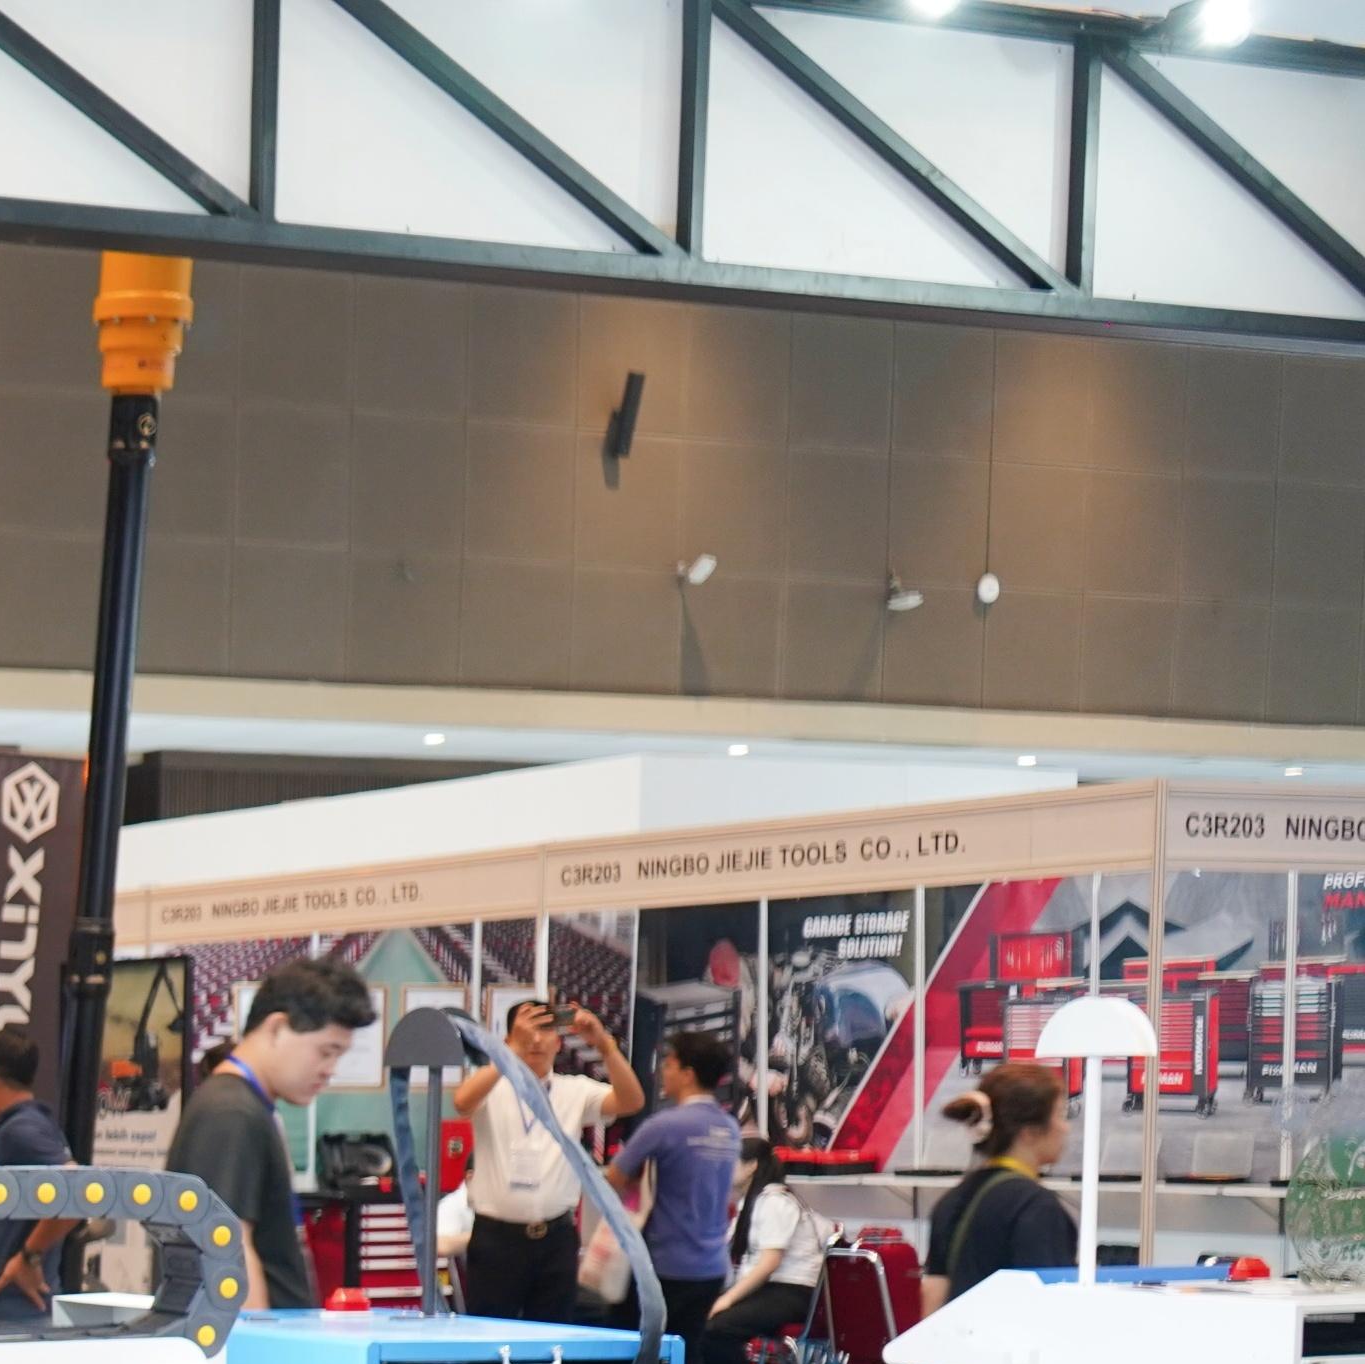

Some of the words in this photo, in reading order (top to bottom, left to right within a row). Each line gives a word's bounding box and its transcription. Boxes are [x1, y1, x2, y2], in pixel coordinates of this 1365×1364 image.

[1185, 811, 1266, 839] C3R203
[560, 864, 622, 888] C3R203
[637, 853, 710, 880] NINGBO
[715, 847, 772, 874] JIEJIE
[779, 840, 847, 868] TOOLS
[1323, 870, 1365, 891] PROF
[212, 899, 260, 921] NINGBO
[262, 894, 300, 916] JIEJIE
[304, 889, 348, 912] TOOLS
[803, 912, 853, 939] GARAGE
[854, 909, 911, 936] STORAGE
[837, 933, 904, 960] SOLUTION!
